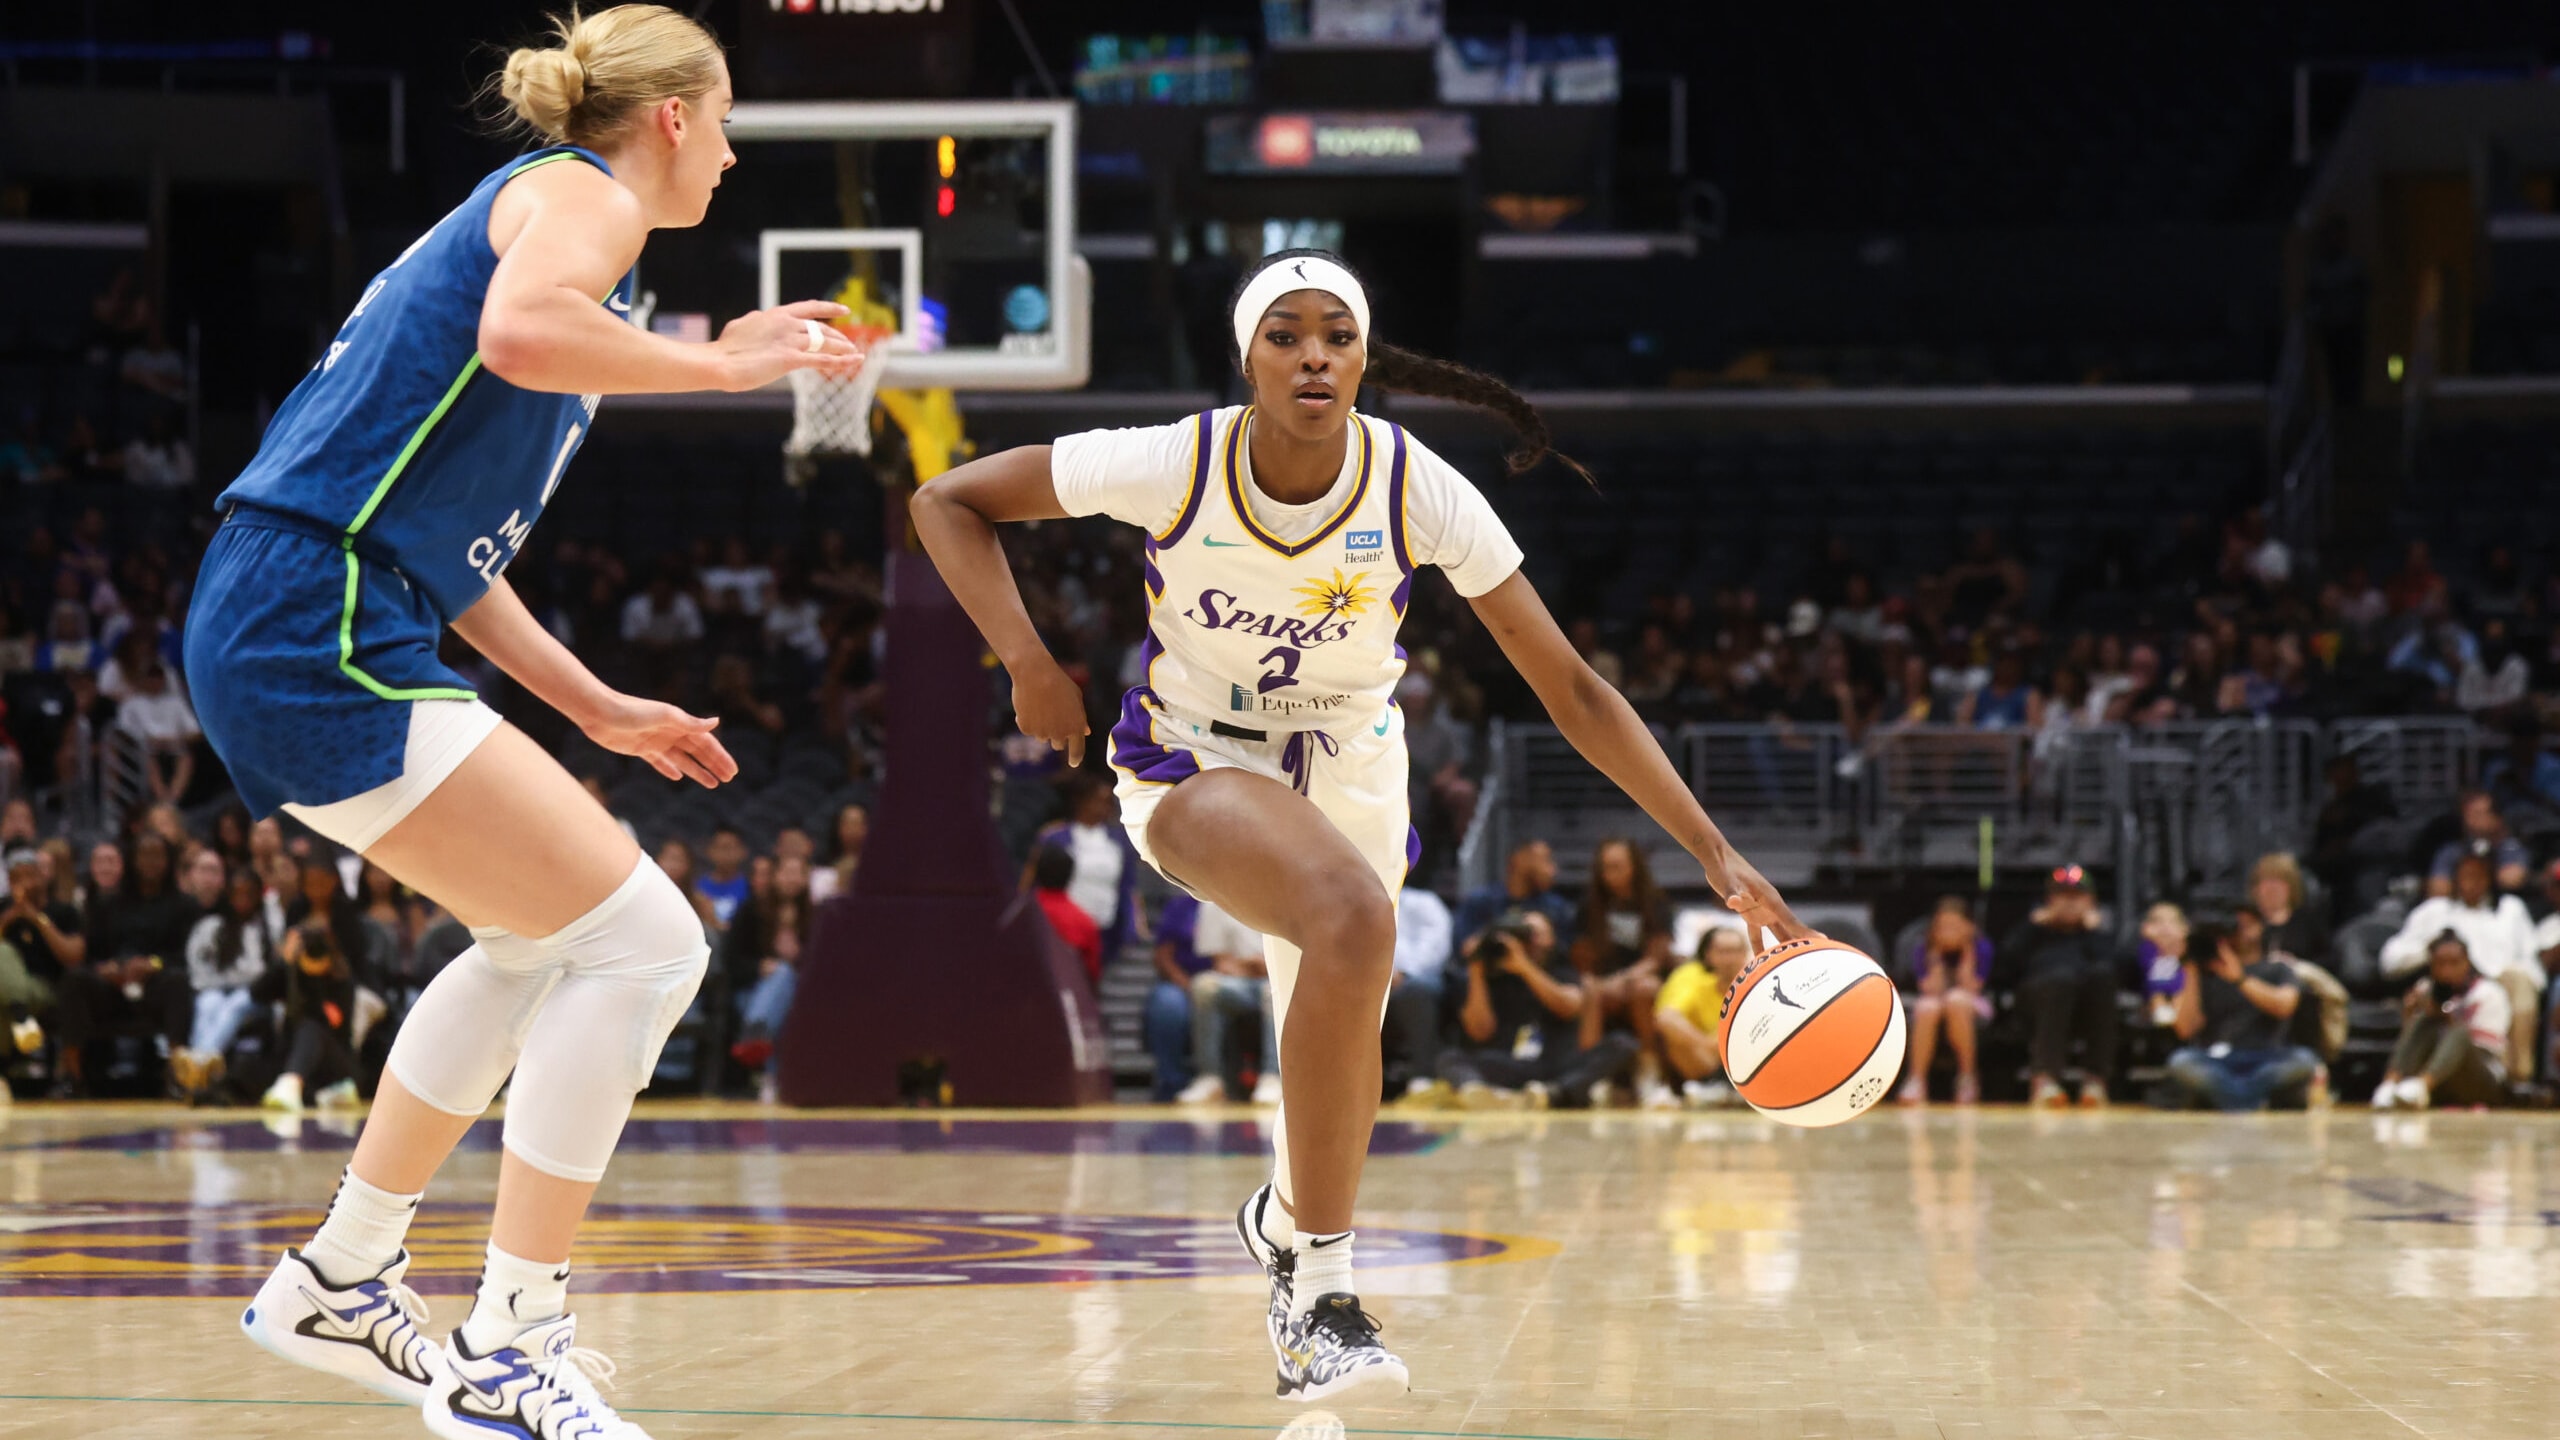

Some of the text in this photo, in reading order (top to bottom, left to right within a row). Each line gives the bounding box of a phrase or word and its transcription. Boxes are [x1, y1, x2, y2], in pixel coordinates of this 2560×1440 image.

[1350, 535, 1378, 545] UCLA
[1344, 551, 1381, 564] Health
[1257, 645, 1301, 695] 2
[1261, 693, 1352, 715] EquTrus
